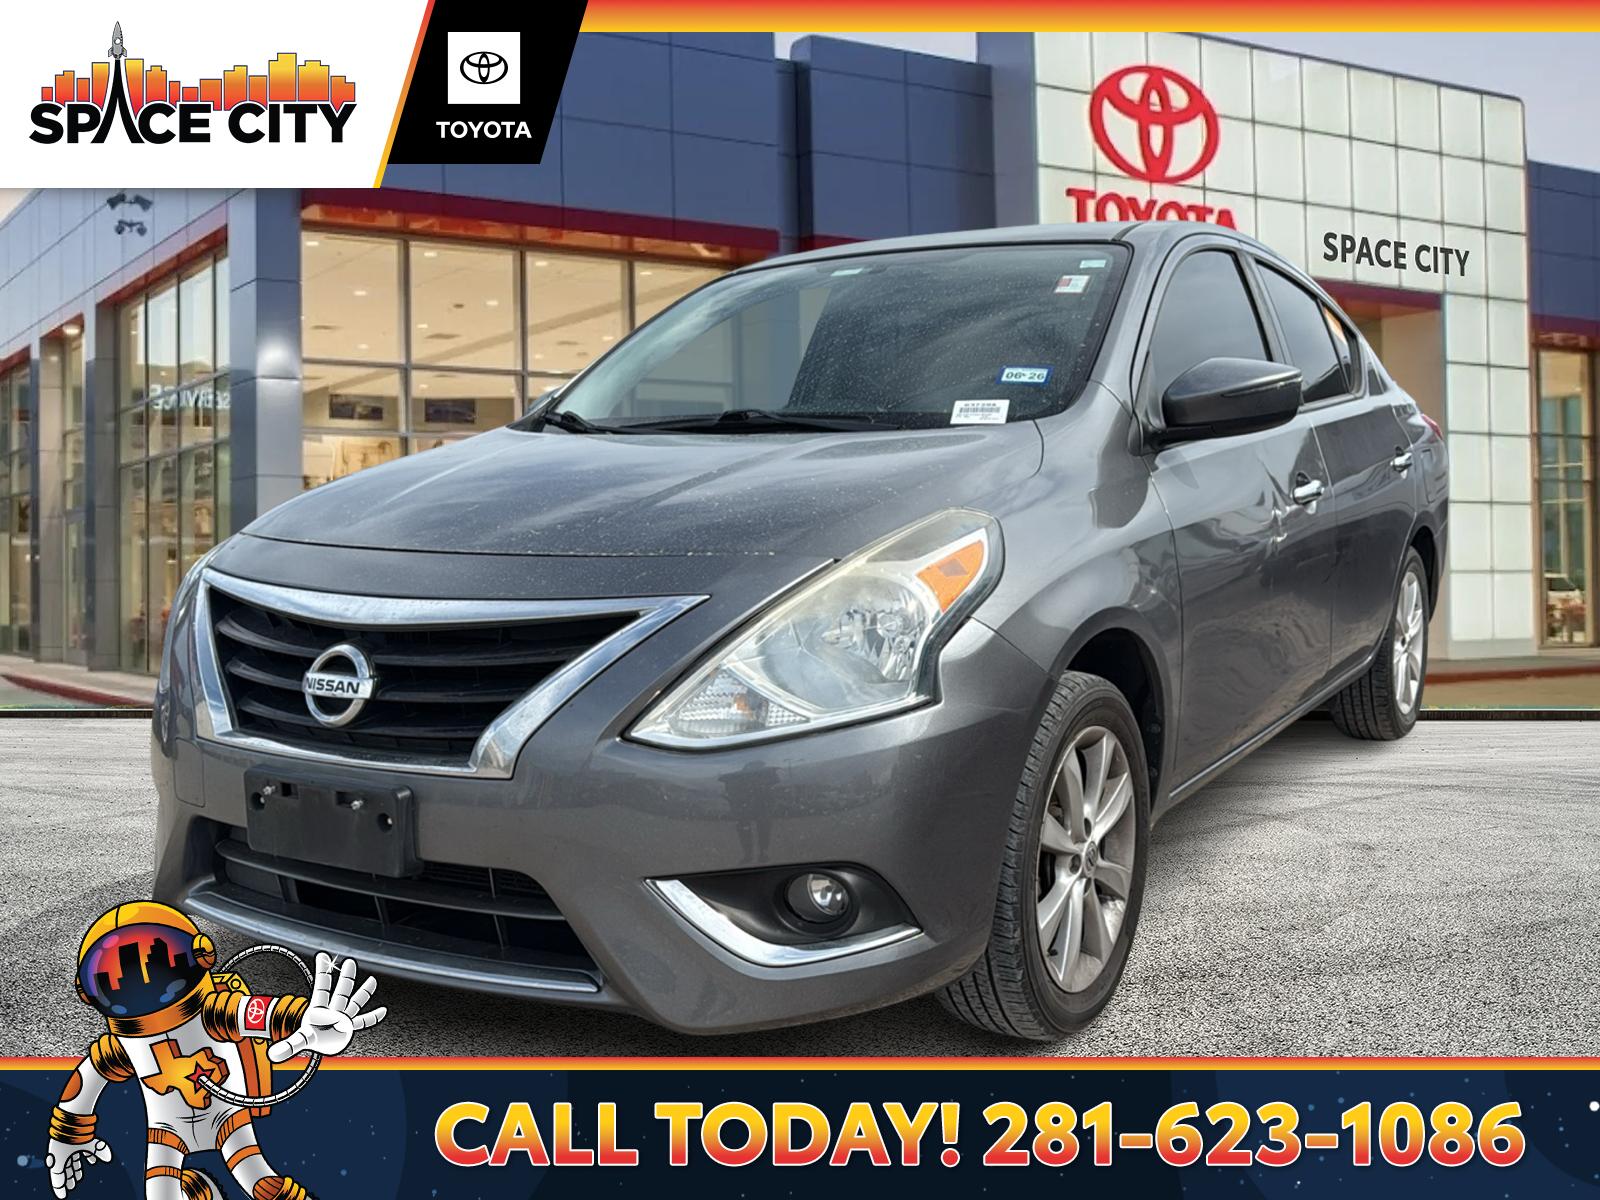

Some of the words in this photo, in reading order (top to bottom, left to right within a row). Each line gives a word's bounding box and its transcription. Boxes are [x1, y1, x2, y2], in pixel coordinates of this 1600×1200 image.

[1323, 232, 1407, 270] SPACE
[1414, 244, 1470, 277] CITY
[306, 677, 360, 695] NISSAN
